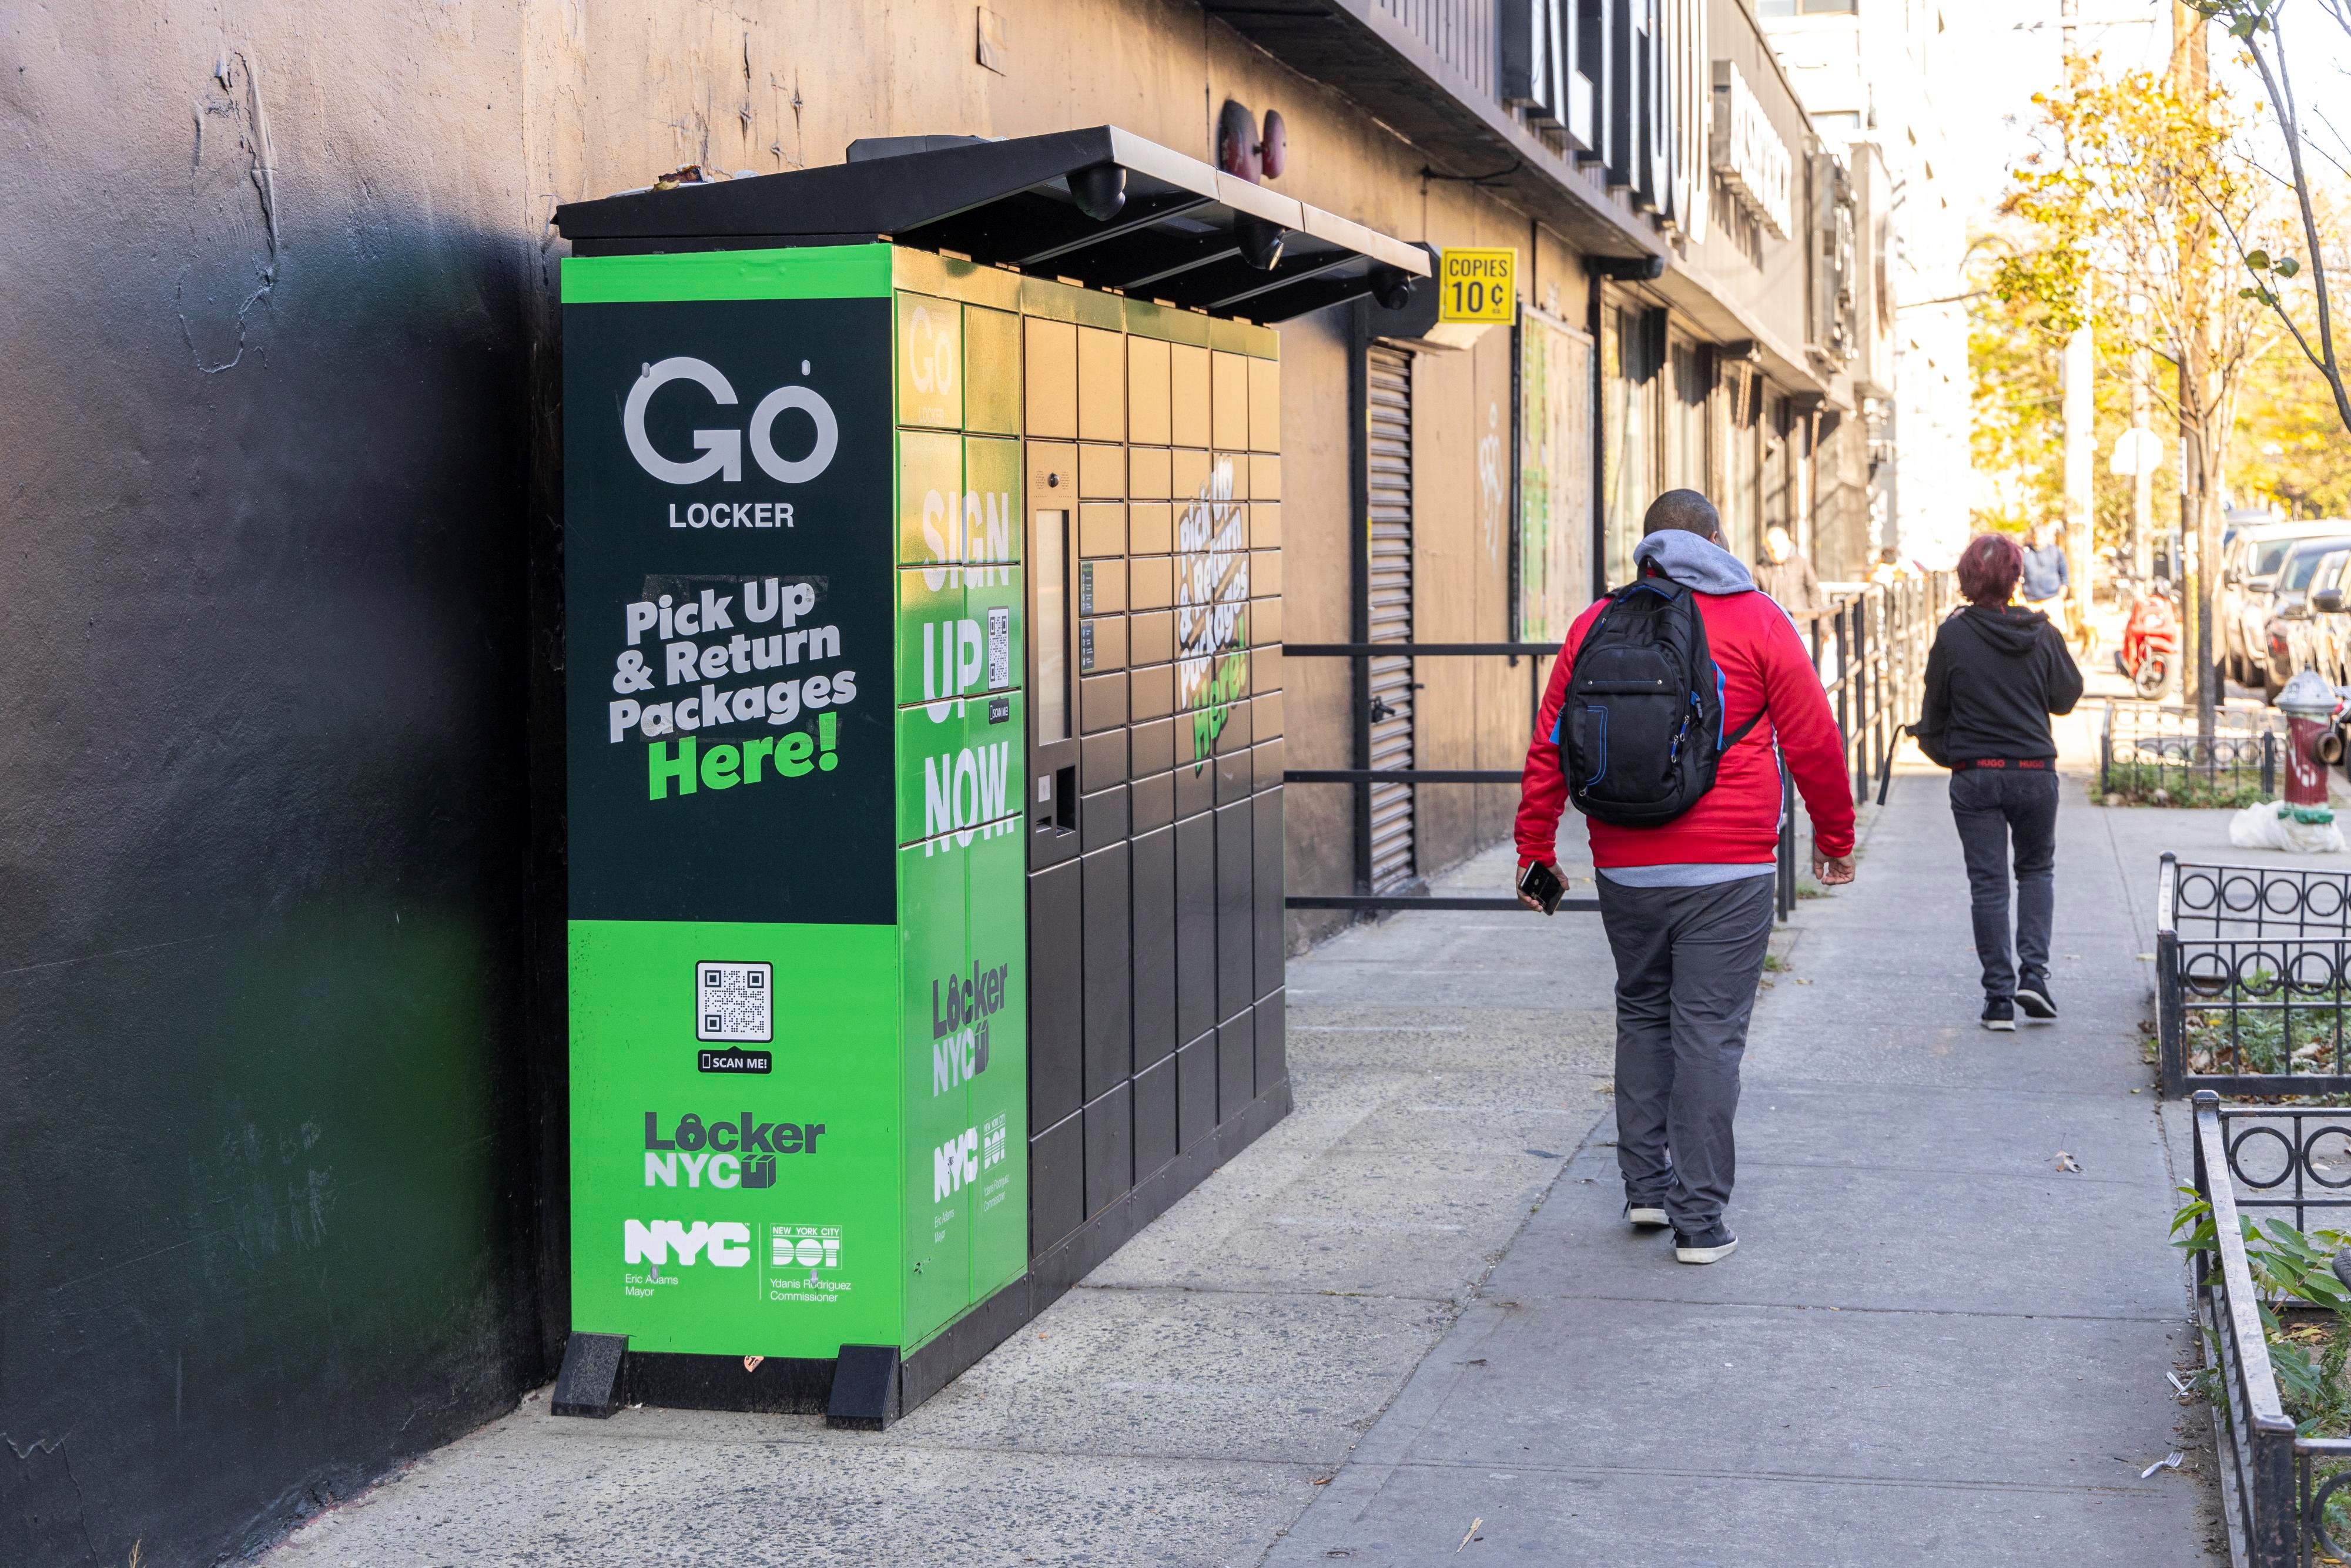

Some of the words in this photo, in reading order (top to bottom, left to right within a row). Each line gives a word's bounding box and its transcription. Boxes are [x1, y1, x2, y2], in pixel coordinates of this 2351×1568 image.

[1449, 259, 1508, 277] COPIES
[919, 407, 945, 424] LOCKER
[669, 503, 793, 528] LOCKER
[923, 489, 1009, 592] SIGN
[627, 588, 734, 645] Pick
[744, 578, 815, 628] Up
[612, 649, 655, 694] &
[666, 625, 841, 685] Return
[923, 619, 982, 724] UP
[609, 671, 857, 743] Packages
[993, 707, 1002, 718] SCAN
[648, 711, 838, 800] Here!
[1976, 759, 2005, 768] HUGO
[2019, 760, 2044, 769] HUGO
[925, 740, 1014, 858] NOW.
[933, 959, 1007, 1040] Locker
[713, 1058, 744, 1068] SCAN
[747, 1058, 767, 1068] ME!
[933, 1028, 975, 1098] NYC
[645, 1111, 826, 1154] Locker
[984, 1127, 1006, 1170] DOT
[645, 1152, 741, 1188] NYC
[934, 1126, 978, 1204] NYC
[625, 1219, 751, 1267] NYC
[796, 1227, 818, 1235] YORK
[821, 1228, 839, 1236] CITY
[772, 1238, 839, 1267] DOT
[625, 1274, 642, 1284] Eric
[625, 1286, 654, 1298] Mayor
[770, 1278, 801, 1288] Ydanis
[803, 1279, 851, 1292] Rodriguez
[770, 1291, 838, 1302] Commissioner
